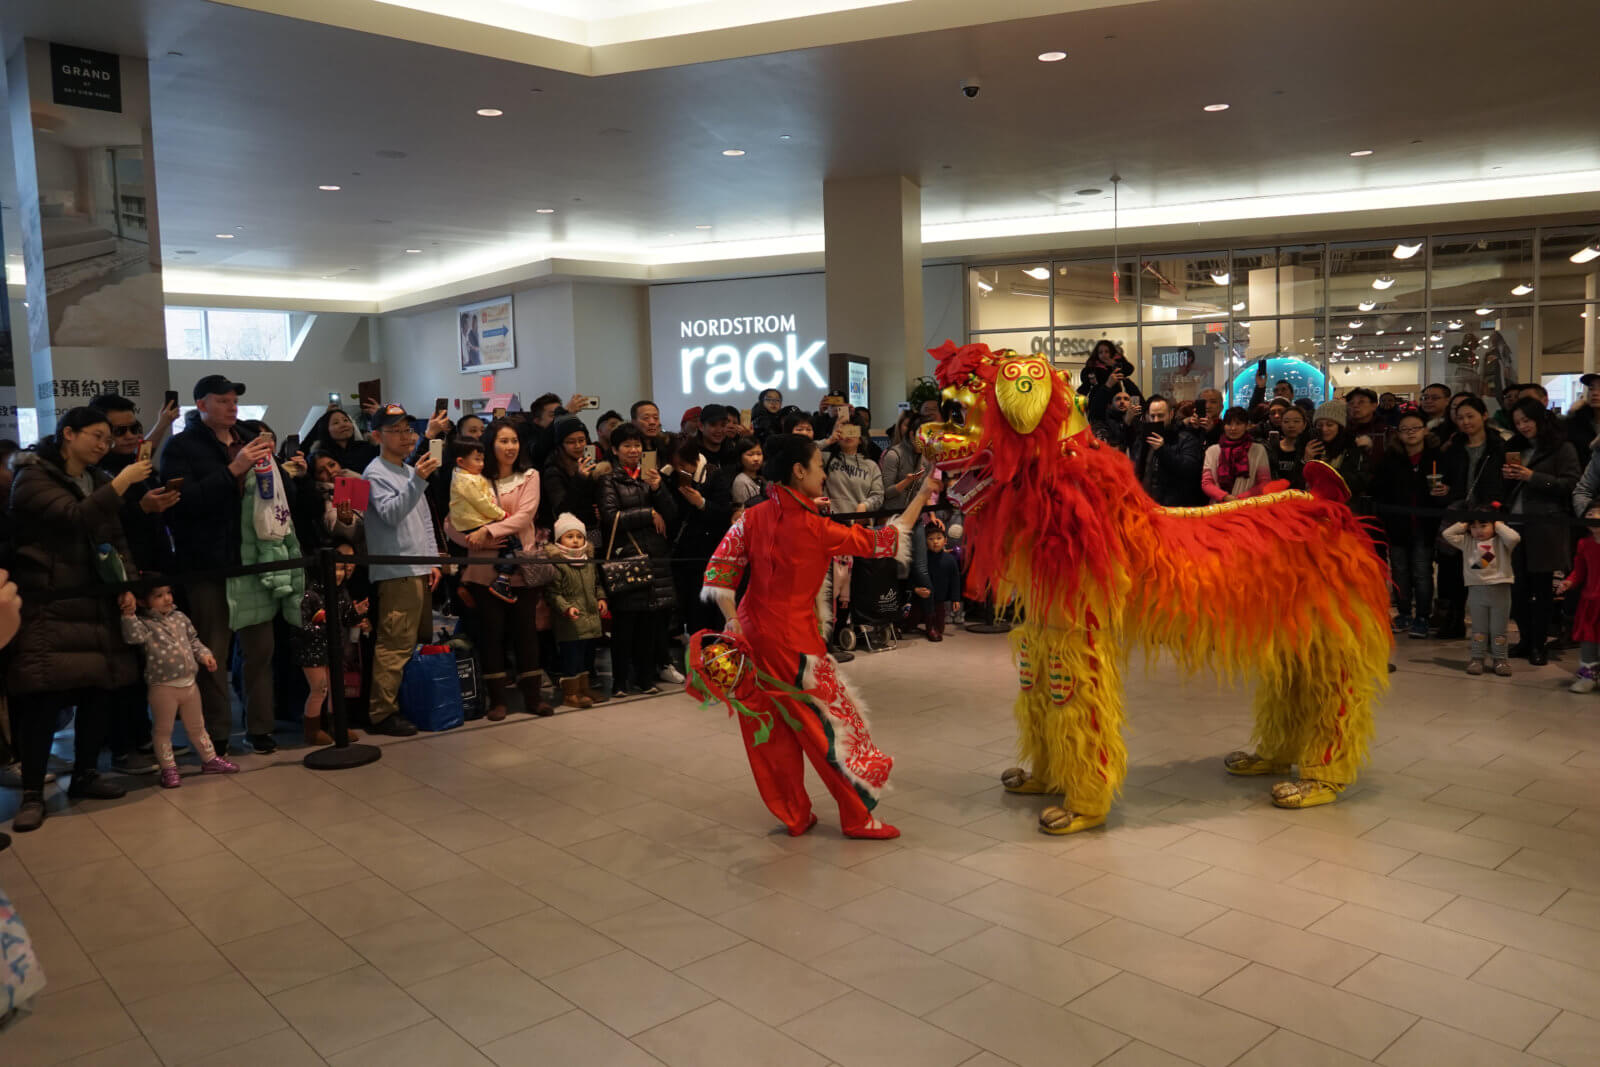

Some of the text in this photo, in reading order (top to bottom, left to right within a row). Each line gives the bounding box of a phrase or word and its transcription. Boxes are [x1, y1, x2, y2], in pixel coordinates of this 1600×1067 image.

[62, 65, 111, 80] GRAND
[680, 314, 796, 338] NORDSTROM
[680, 333, 828, 394] rack
